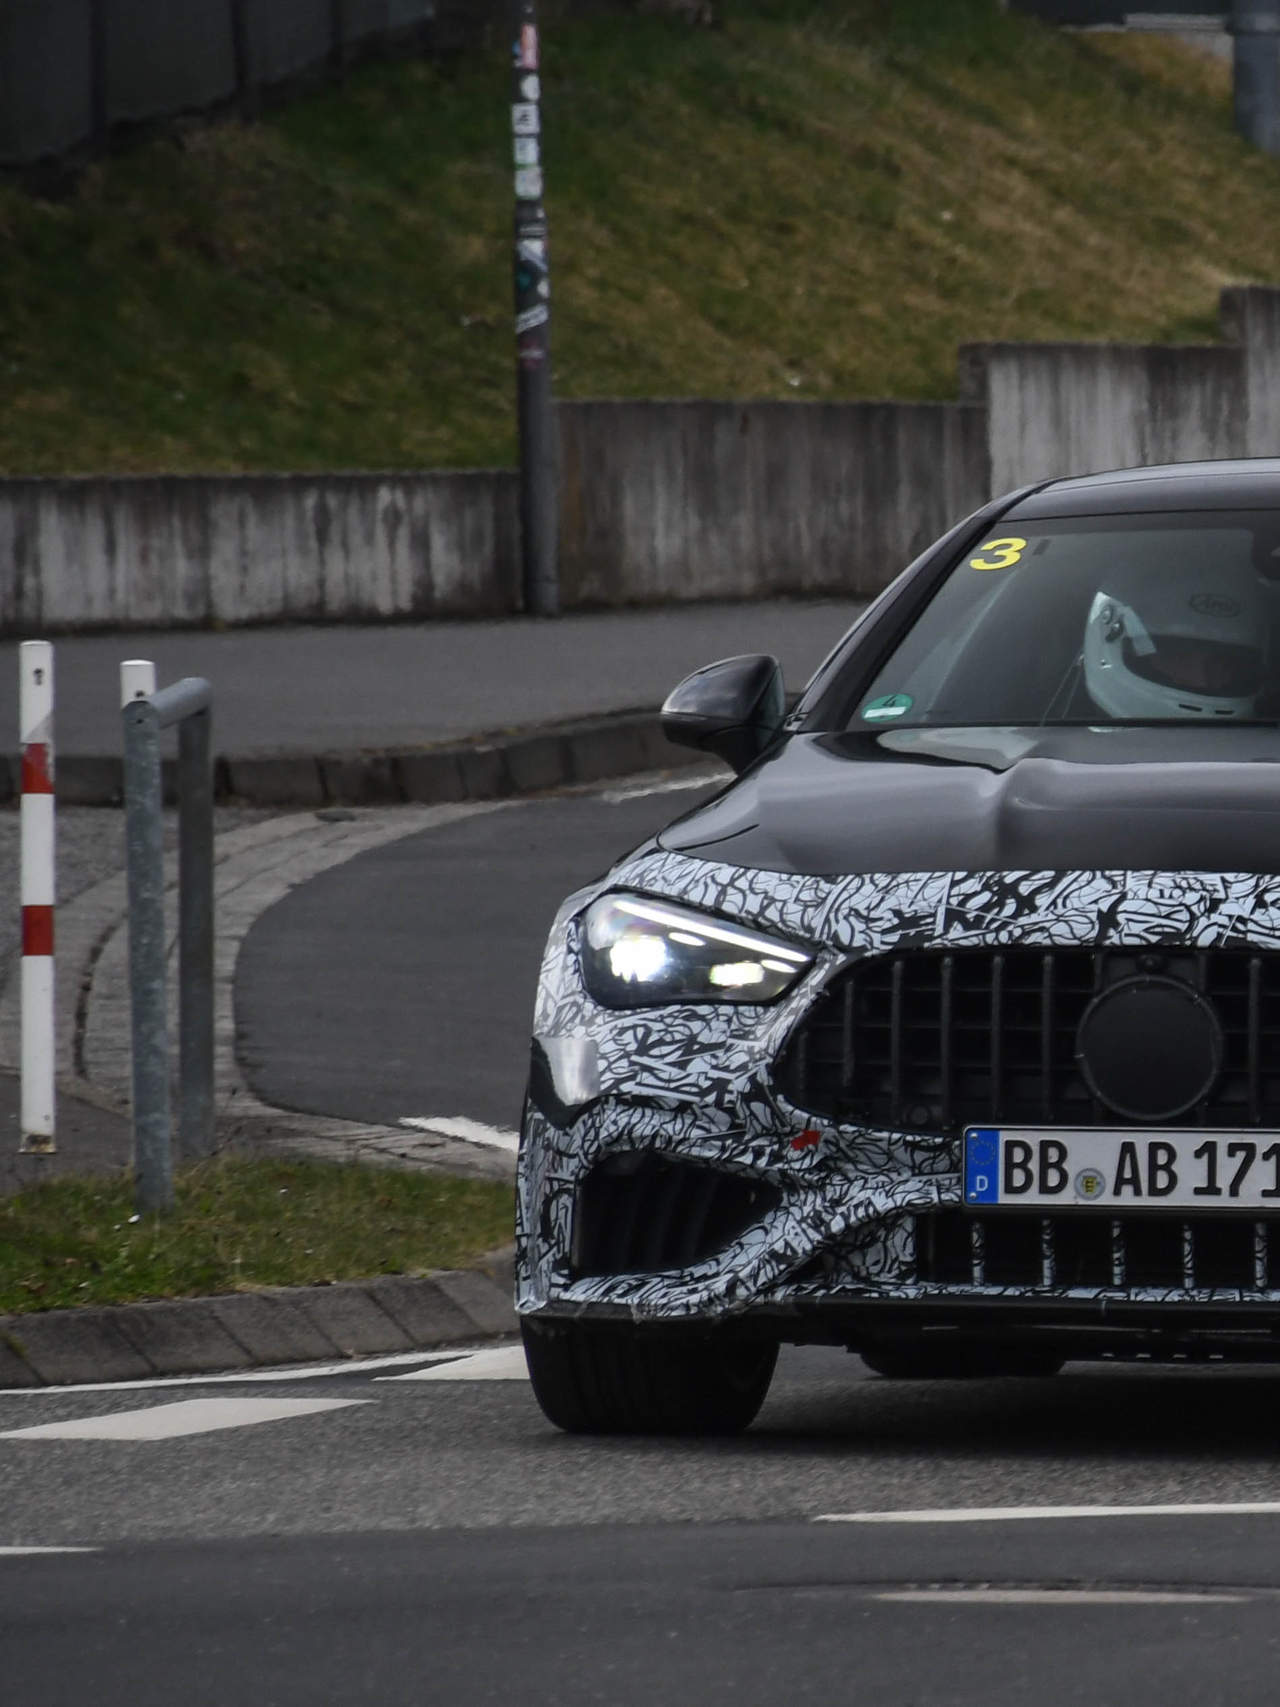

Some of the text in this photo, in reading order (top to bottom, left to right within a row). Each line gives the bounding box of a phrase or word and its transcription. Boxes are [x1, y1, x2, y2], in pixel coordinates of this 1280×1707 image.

[969, 537, 1027, 571] 3
[975, 1176, 988, 1192] D
[1004, 1139, 1069, 1195] BB
[1113, 1141, 1178, 1197] AB
